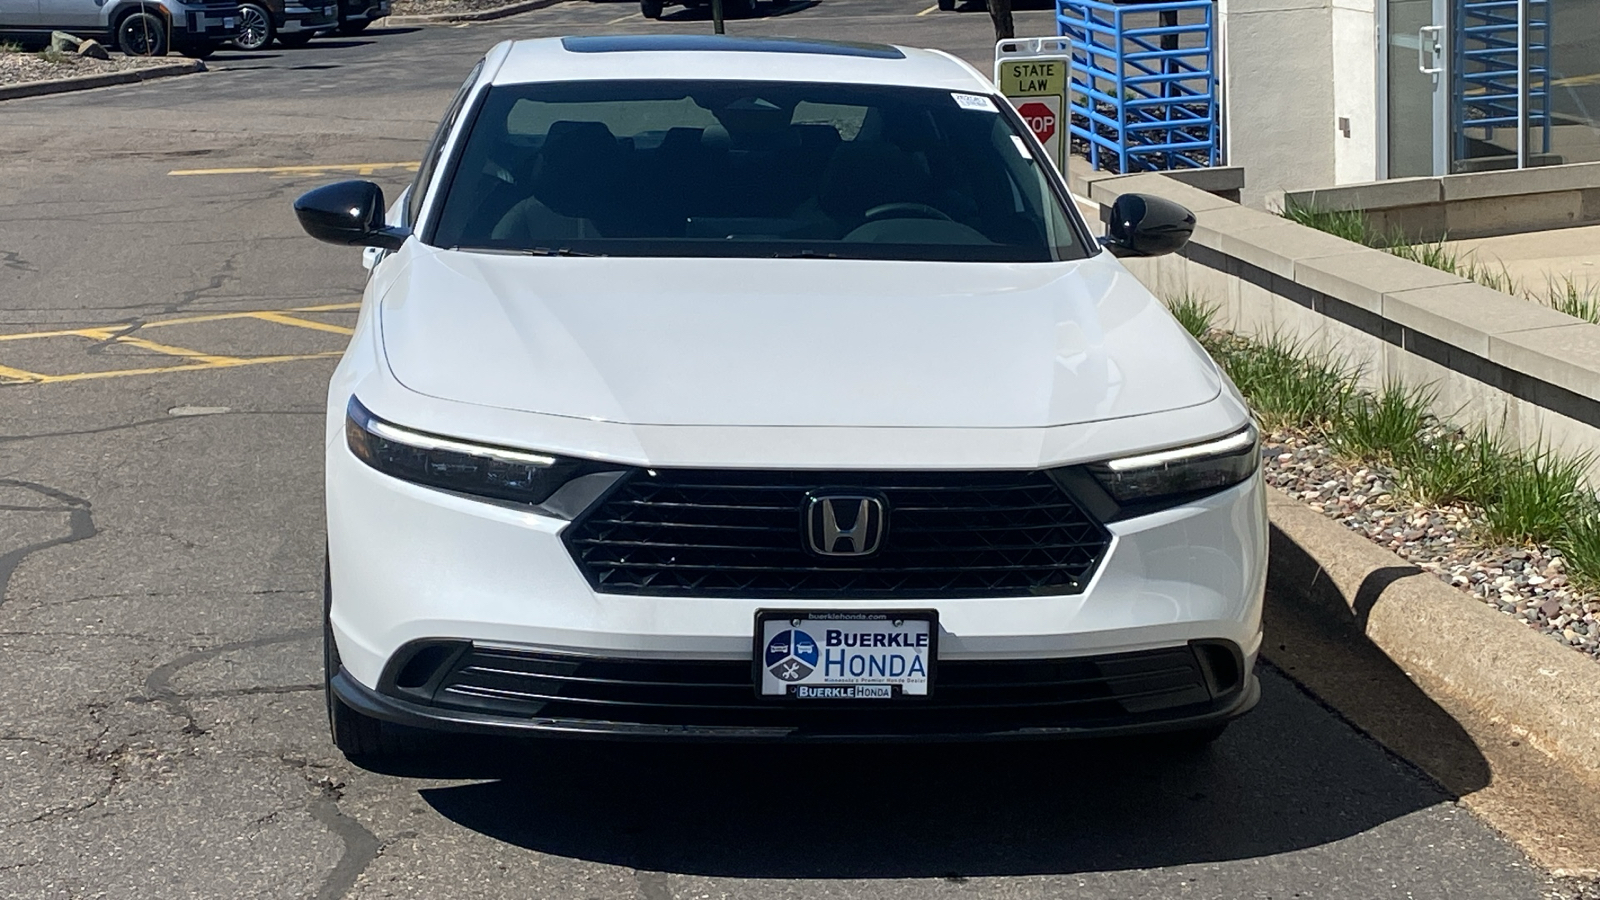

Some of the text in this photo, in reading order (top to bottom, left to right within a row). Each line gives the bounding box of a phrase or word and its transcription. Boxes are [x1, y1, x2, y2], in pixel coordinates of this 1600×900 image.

[1013, 64, 1055, 78] STATE
[1019, 80, 1048, 92] LAW
[1024, 116, 1055, 133] TOP
[808, 612, 887, 620] buerklehonda.com
[826, 629, 928, 648] BUERKLE
[824, 648, 926, 677] HONDA
[800, 686, 890, 697] BUERKLE HONDA
